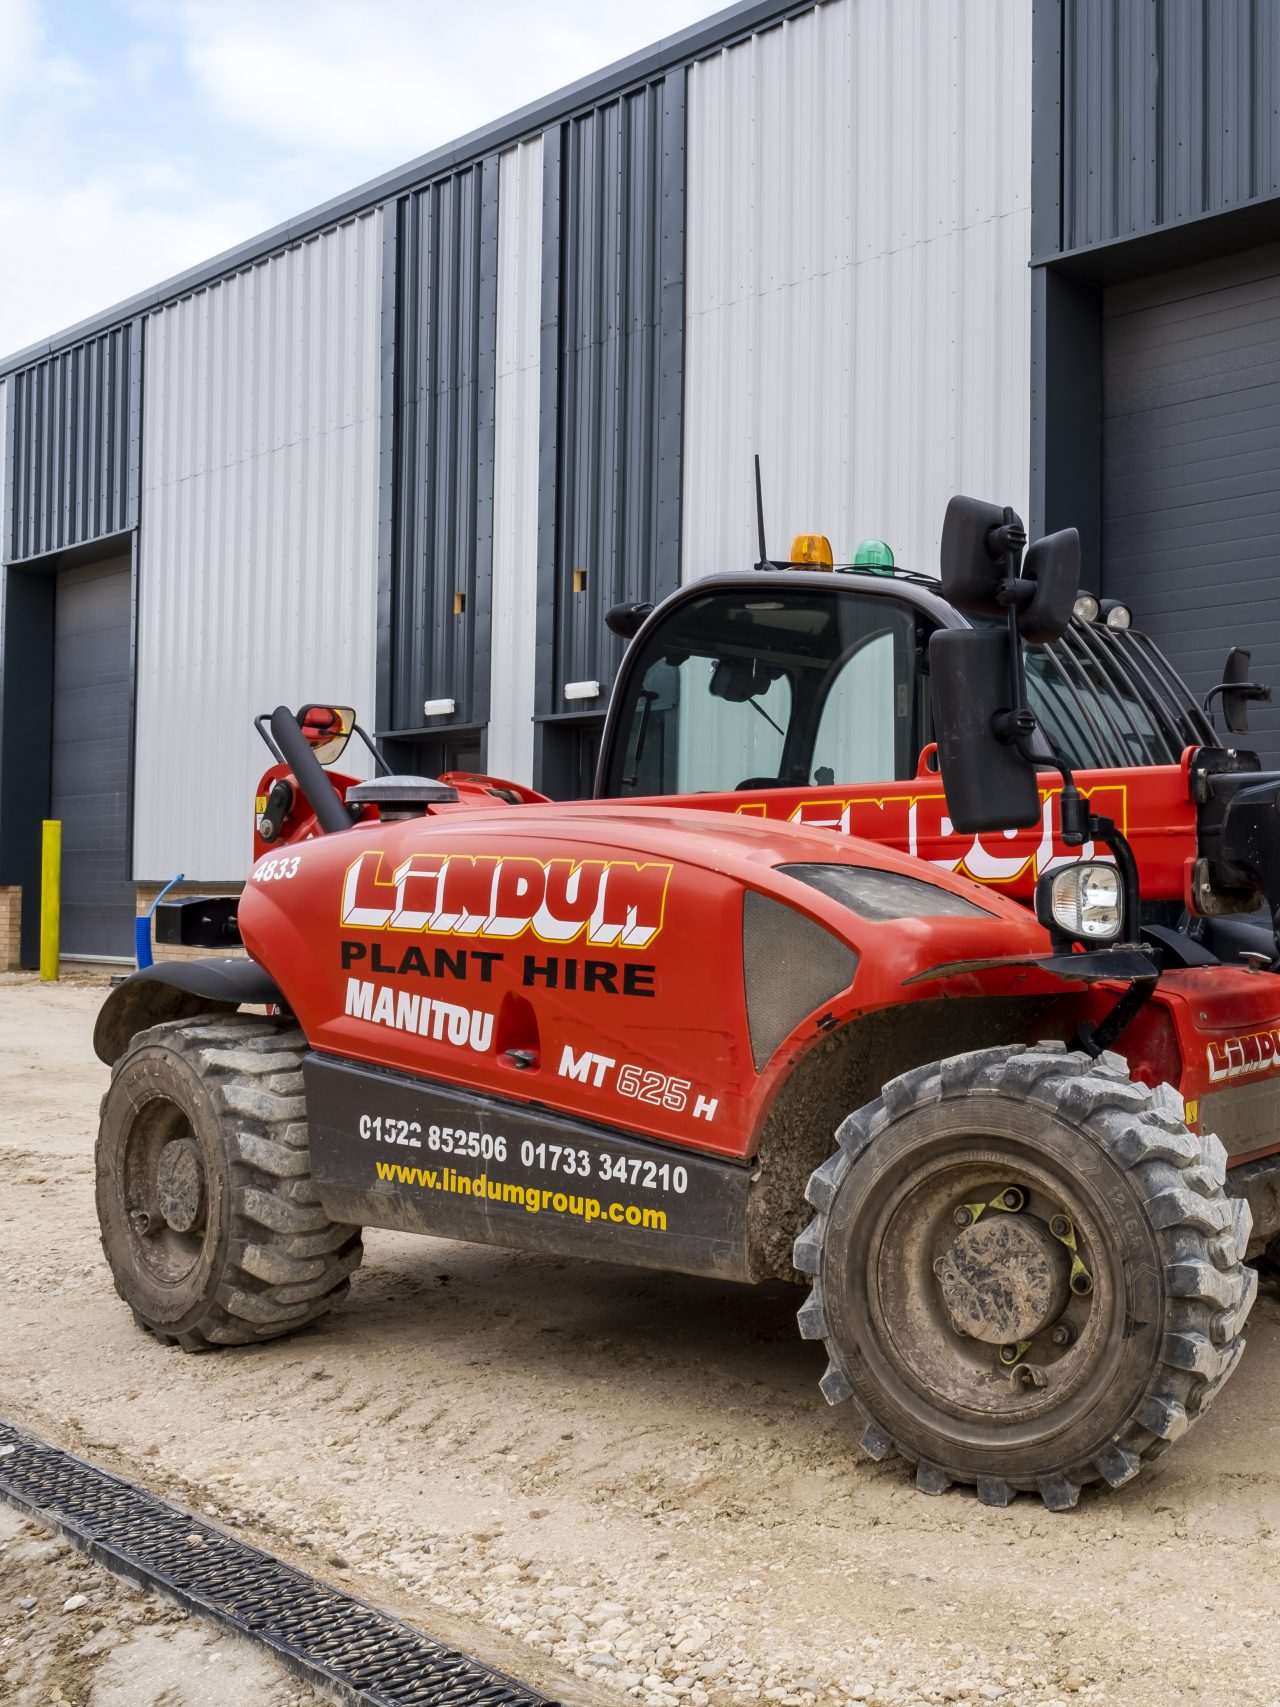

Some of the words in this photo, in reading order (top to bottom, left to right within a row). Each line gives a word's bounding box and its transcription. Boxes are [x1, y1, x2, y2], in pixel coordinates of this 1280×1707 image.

[252, 856, 301, 883] 4833
[340, 941, 504, 983] PLANT
[522, 955, 657, 998] HIRE
[344, 977, 494, 1053] MANITOU
[558, 1045, 615, 1088] MT
[616, 1064, 693, 1112] 625
[692, 1095, 719, 1122] H
[359, 1114, 422, 1149] 01522
[428, 1127, 507, 1162] 852506
[520, 1141, 591, 1177] 01733
[598, 1153, 688, 1194] 347210
[376, 1158, 668, 1231] www.lindumgroup.com
